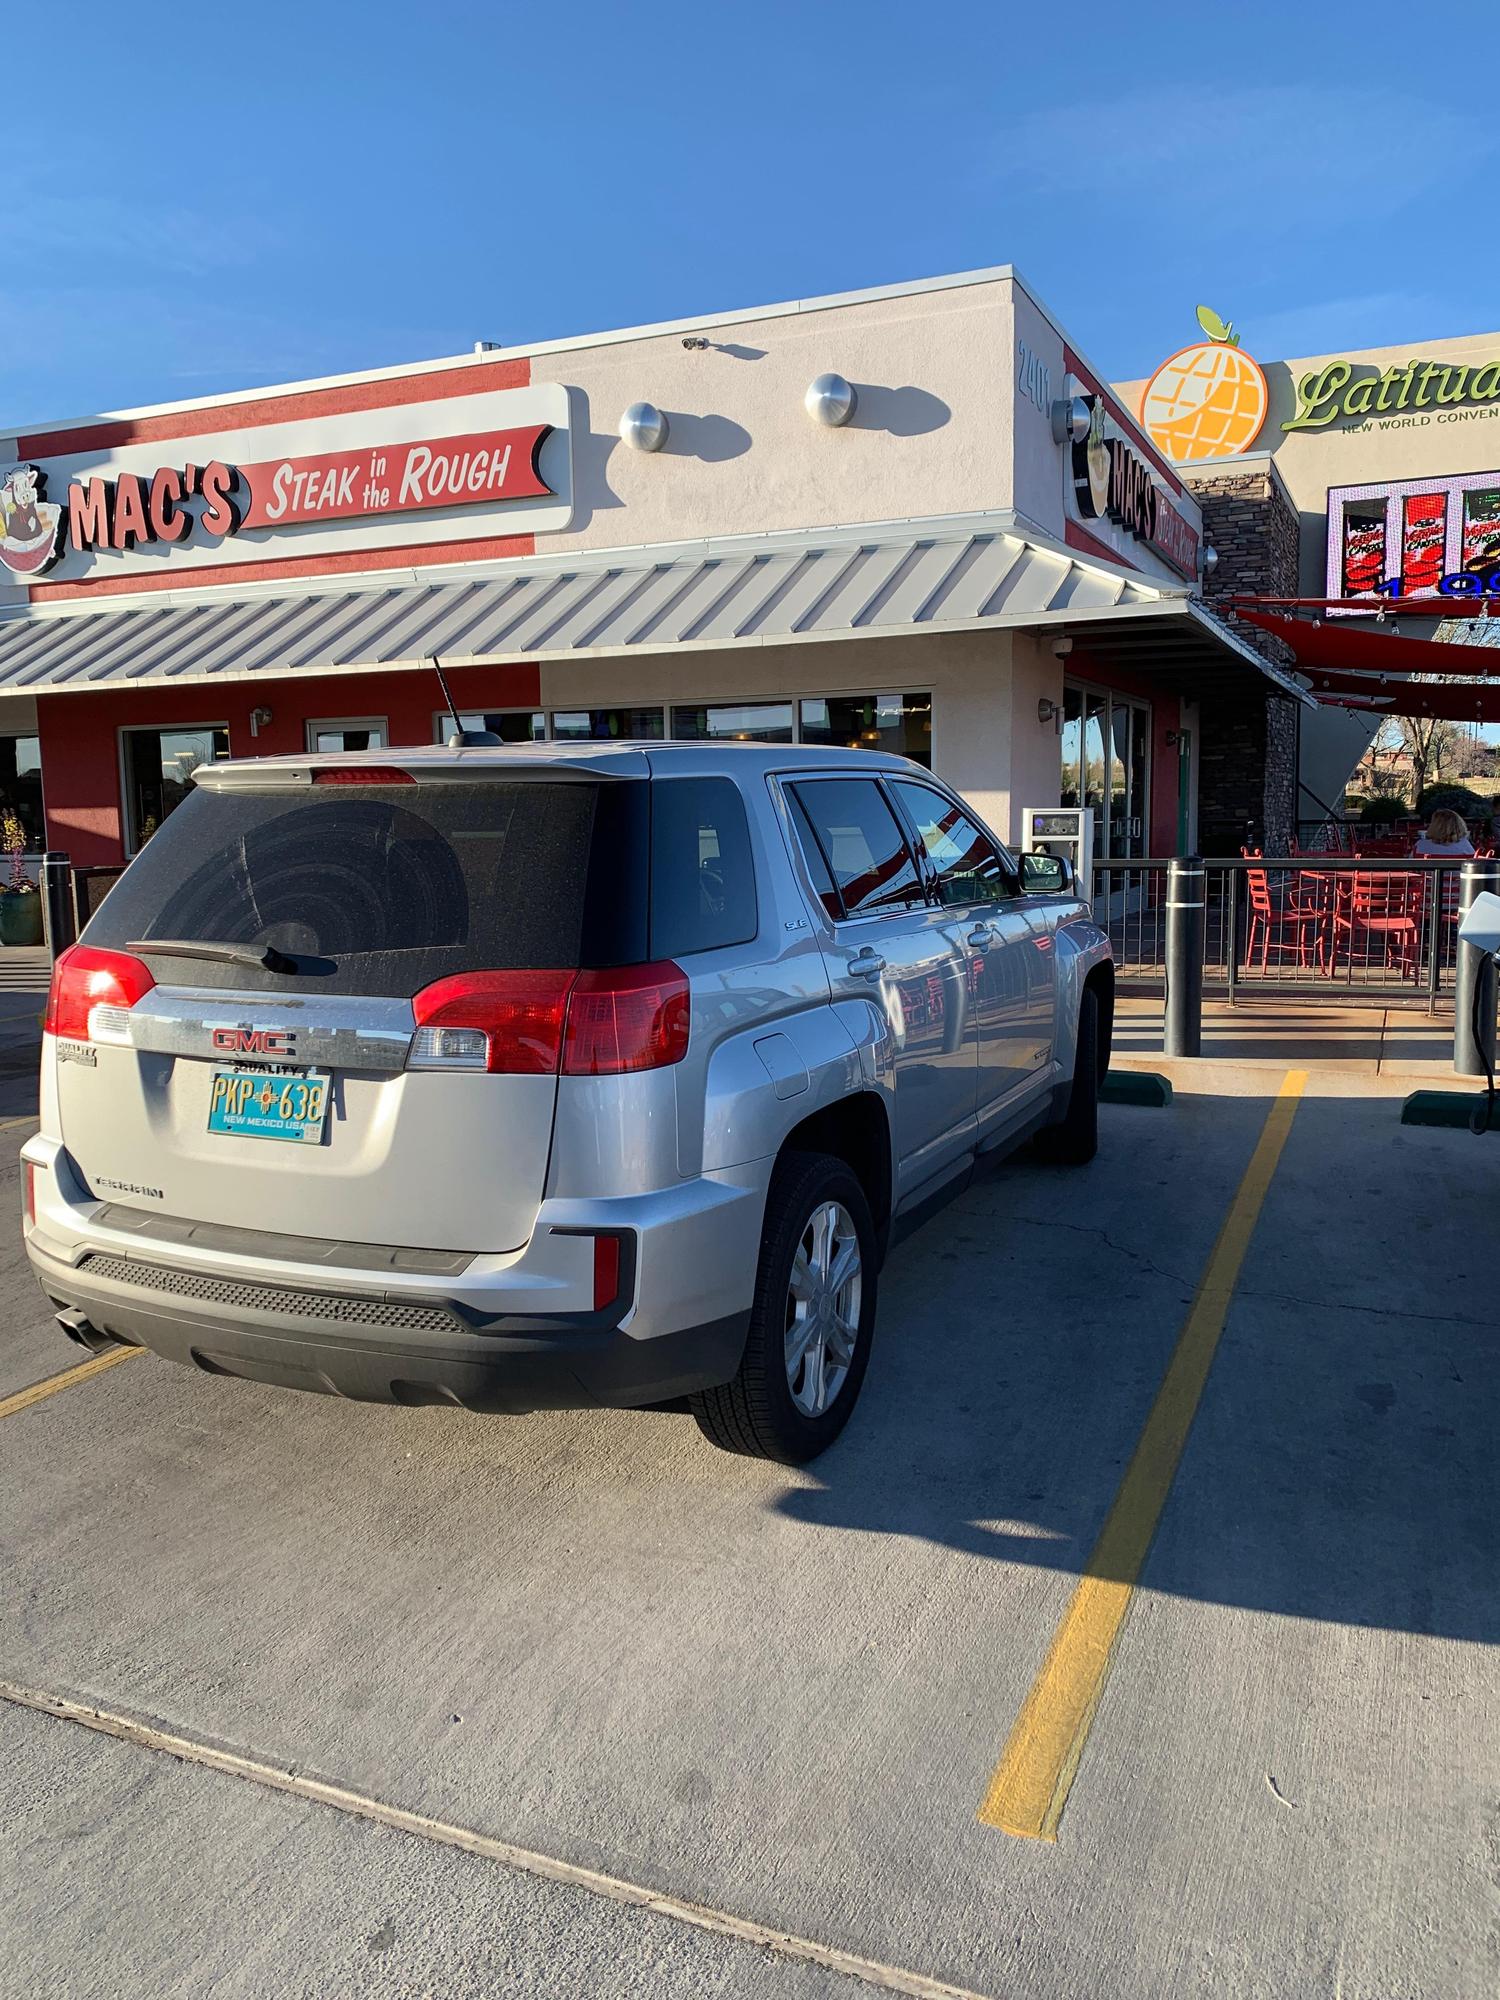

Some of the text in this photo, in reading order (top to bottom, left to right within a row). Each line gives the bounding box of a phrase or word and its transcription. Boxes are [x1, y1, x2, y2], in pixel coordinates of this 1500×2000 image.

[1018, 339, 1051, 420] 2401
[1342, 423, 1373, 435] NEW
[1379, 416, 1431, 430] WORLD
[369, 450, 387, 479] in
[68, 445, 512, 551] MAC'S STEAK ROUGH
[363, 482, 391, 510] the
[212, 1028, 289, 1055] GMC
[239, 1062, 300, 1077] QUALITY
[211, 1077, 323, 1121] PKP 638
[223, 1115, 246, 1125] NEW
[246, 1117, 284, 1129] MEXICO
